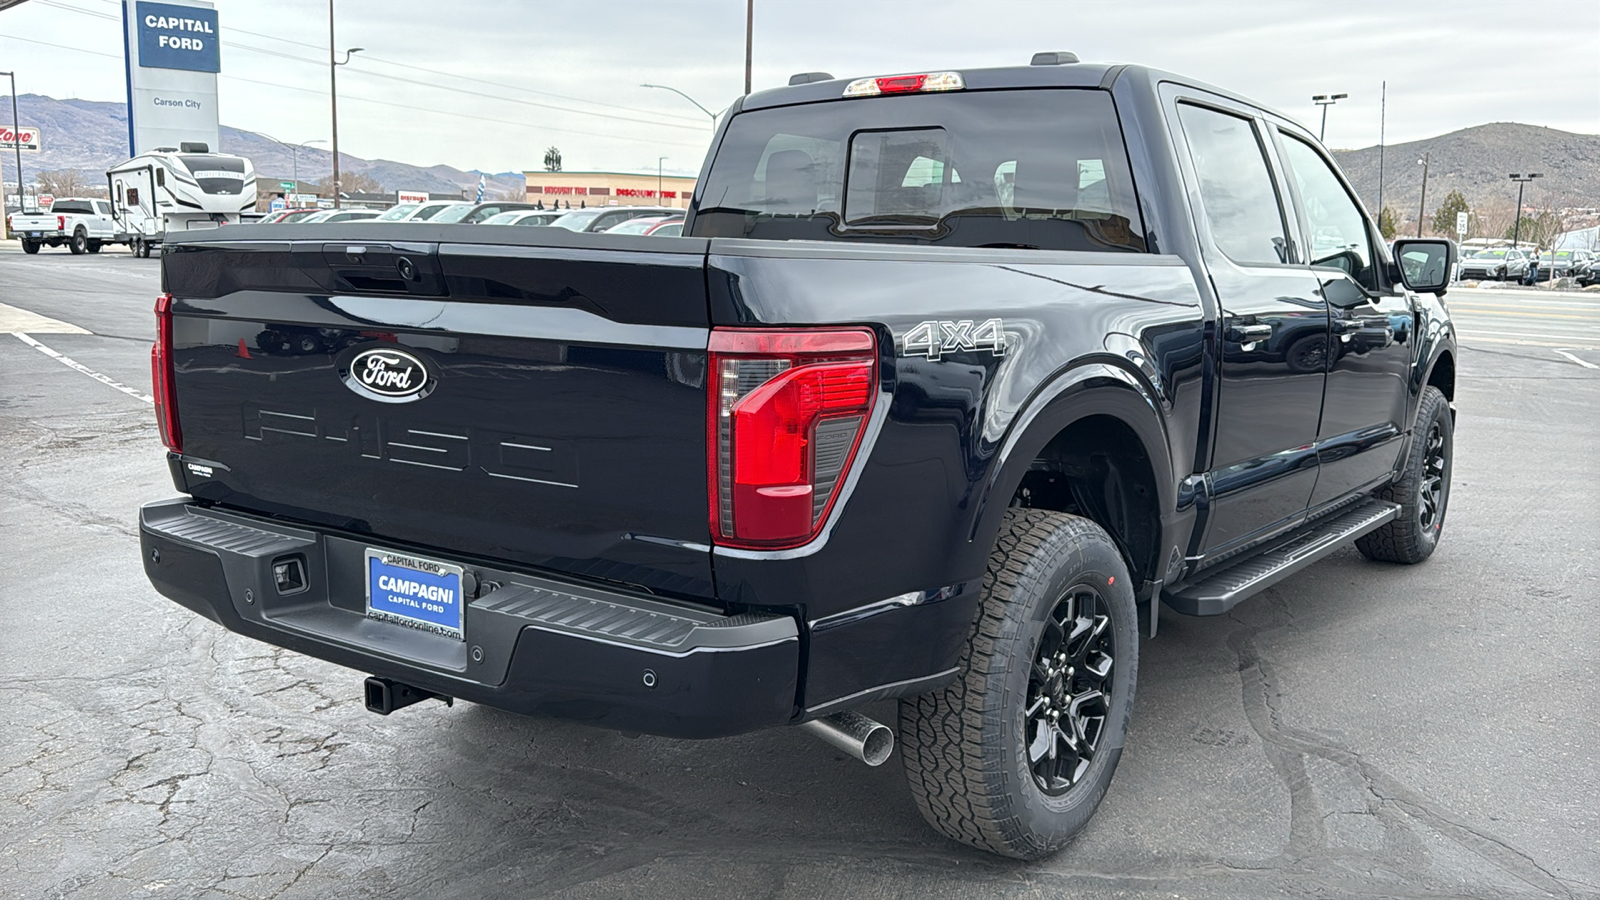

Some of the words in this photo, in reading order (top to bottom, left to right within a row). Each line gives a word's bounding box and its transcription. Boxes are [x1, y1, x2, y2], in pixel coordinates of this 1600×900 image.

[145, 15, 213, 33] CAPITAL
[159, 35, 203, 51] FORD
[153, 97, 183, 107] Carson
[185, 99, 201, 110] City
[616, 188, 657, 198] DISCOUNT
[659, 190, 676, 199] TIRE
[363, 354, 412, 389] Ford
[817, 432, 847, 441] FORD
[386, 555, 418, 569] CAPITAL
[418, 561, 440, 573] FORD
[378, 575, 454, 604] CAMPAGNI
[388, 595, 420, 608] CAPITAL
[422, 602, 444, 613] FORD
[368, 611, 461, 640] capitalfordonline.com
